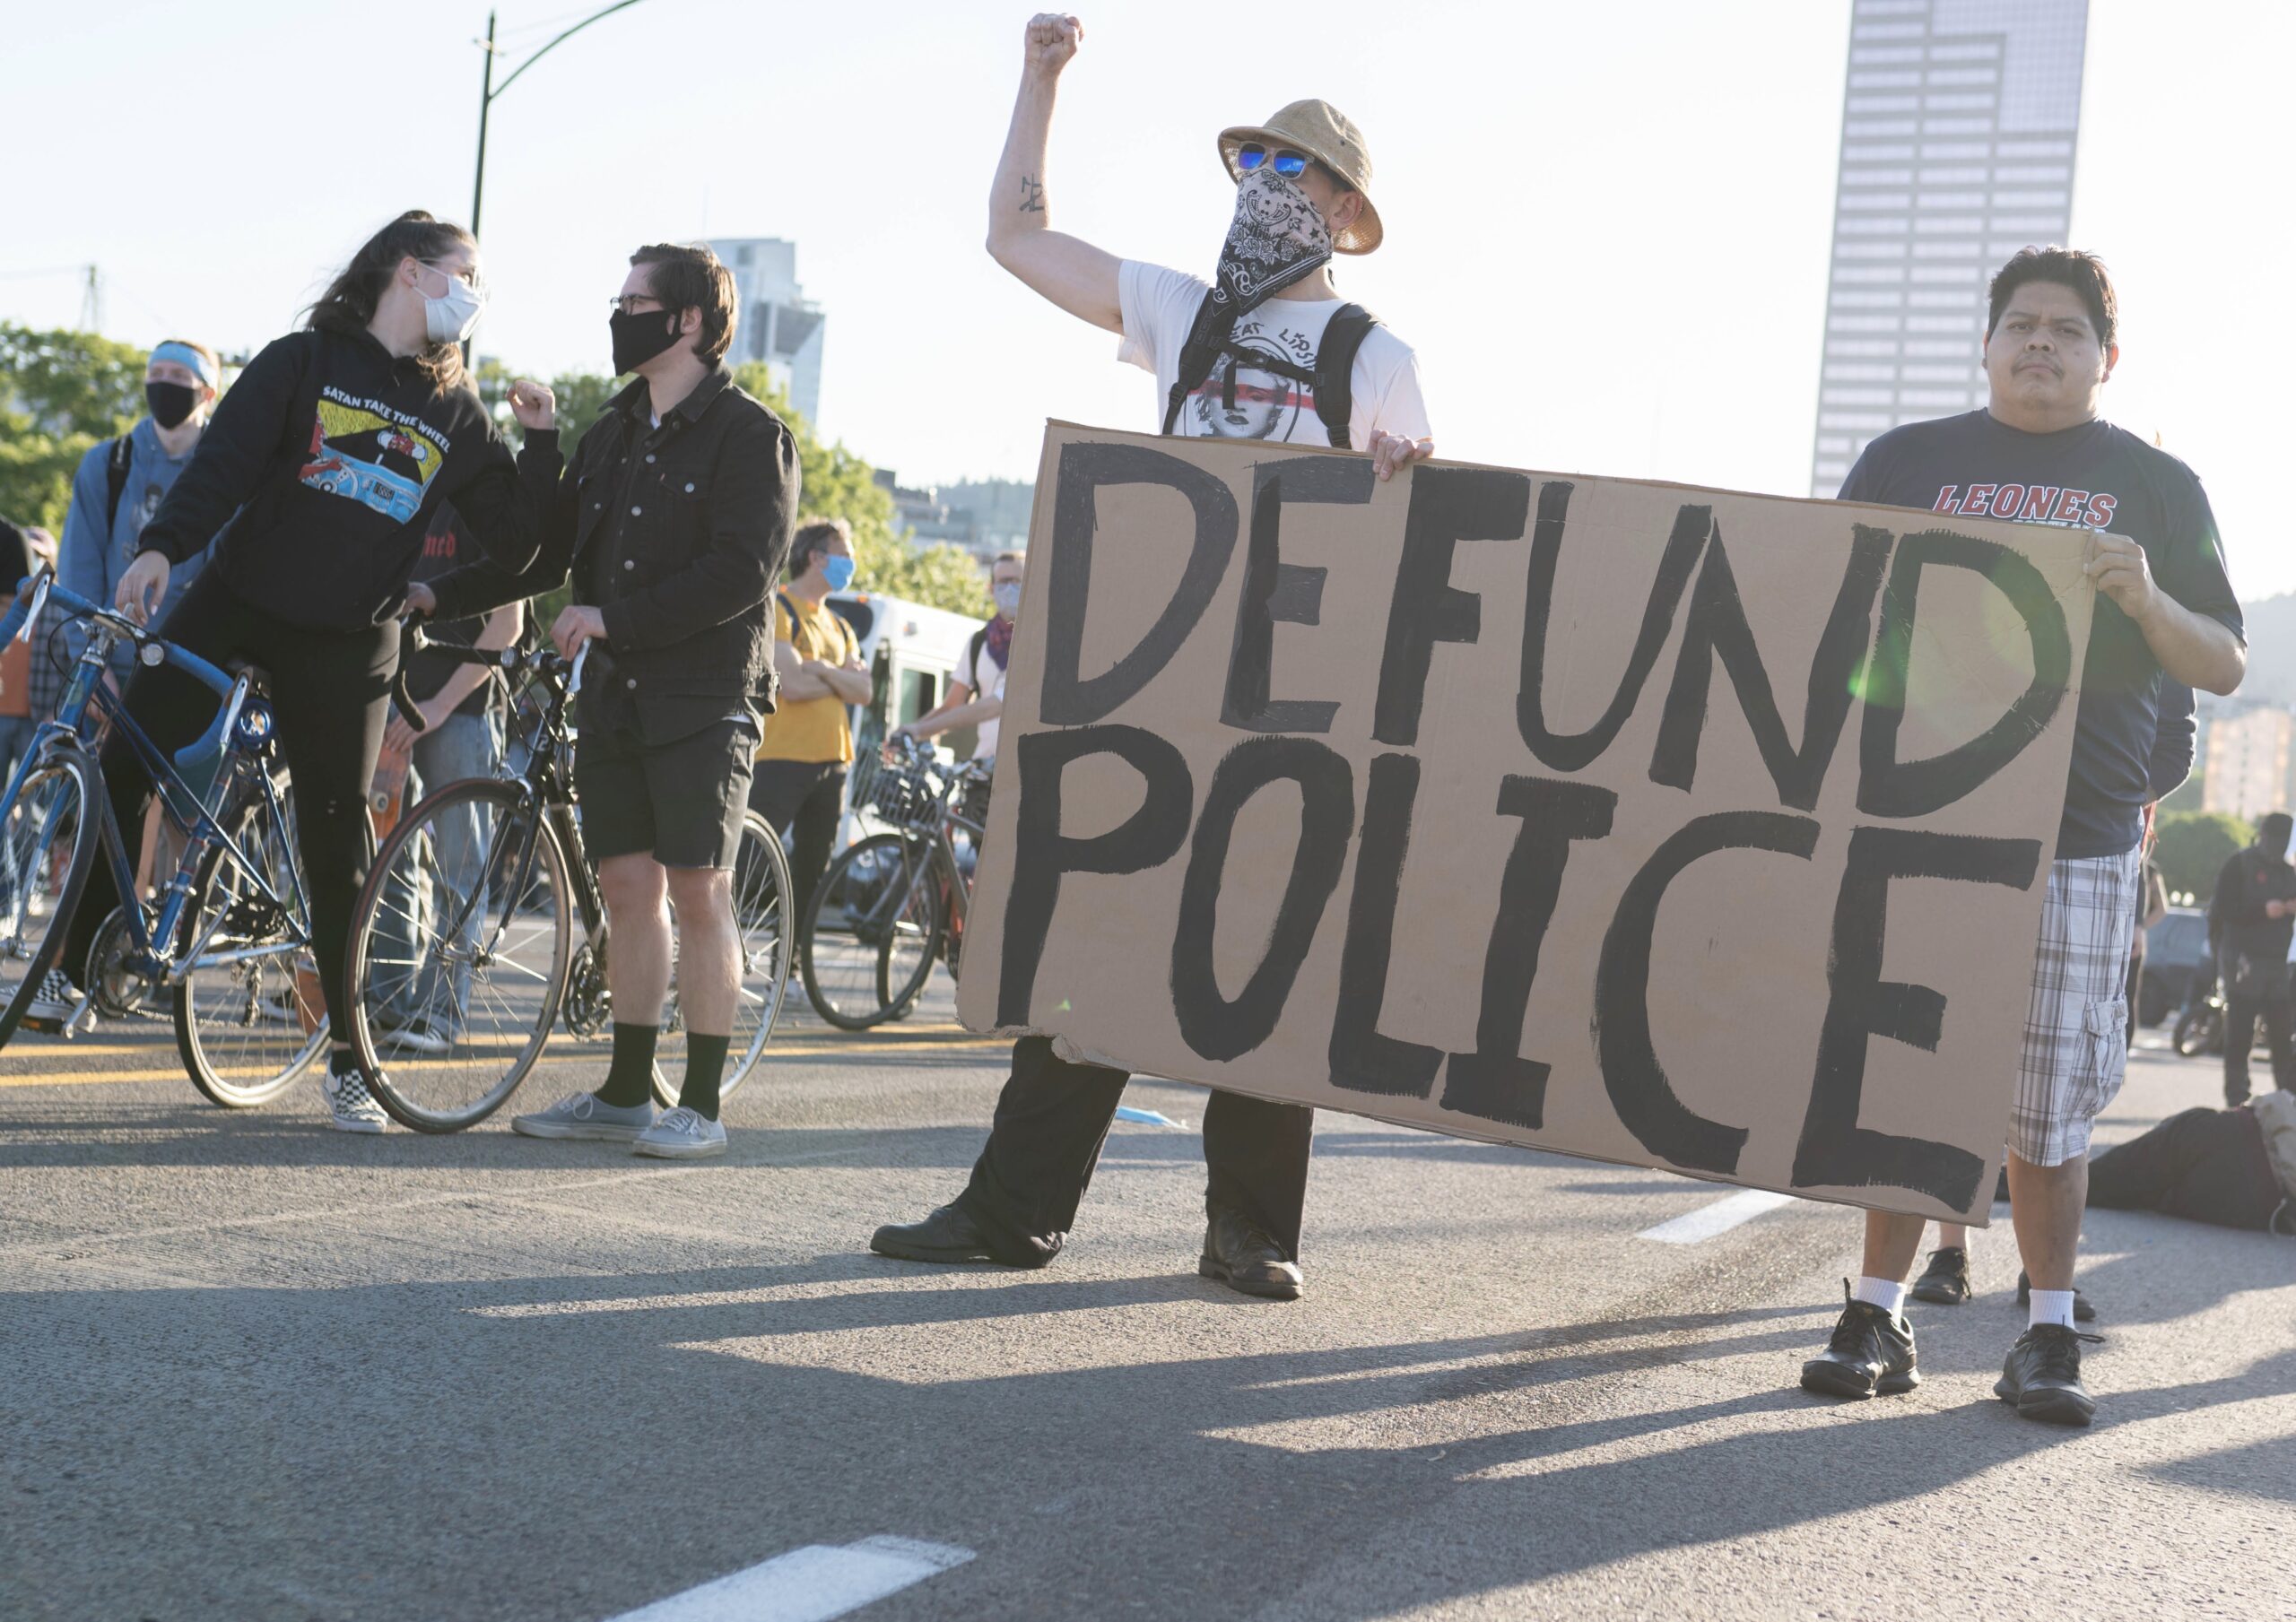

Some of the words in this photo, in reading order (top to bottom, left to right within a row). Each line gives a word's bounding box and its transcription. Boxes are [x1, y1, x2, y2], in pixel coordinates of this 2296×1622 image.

[323, 386, 361, 407] SATAN
[364, 399, 391, 420] TAKE
[393, 411, 418, 426] THE
[419, 419, 451, 454] WHEEL
[1932, 483, 2118, 528] LEONES
[1040, 441, 2073, 818] DEFUND
[996, 724, 2042, 1213] POLICE
